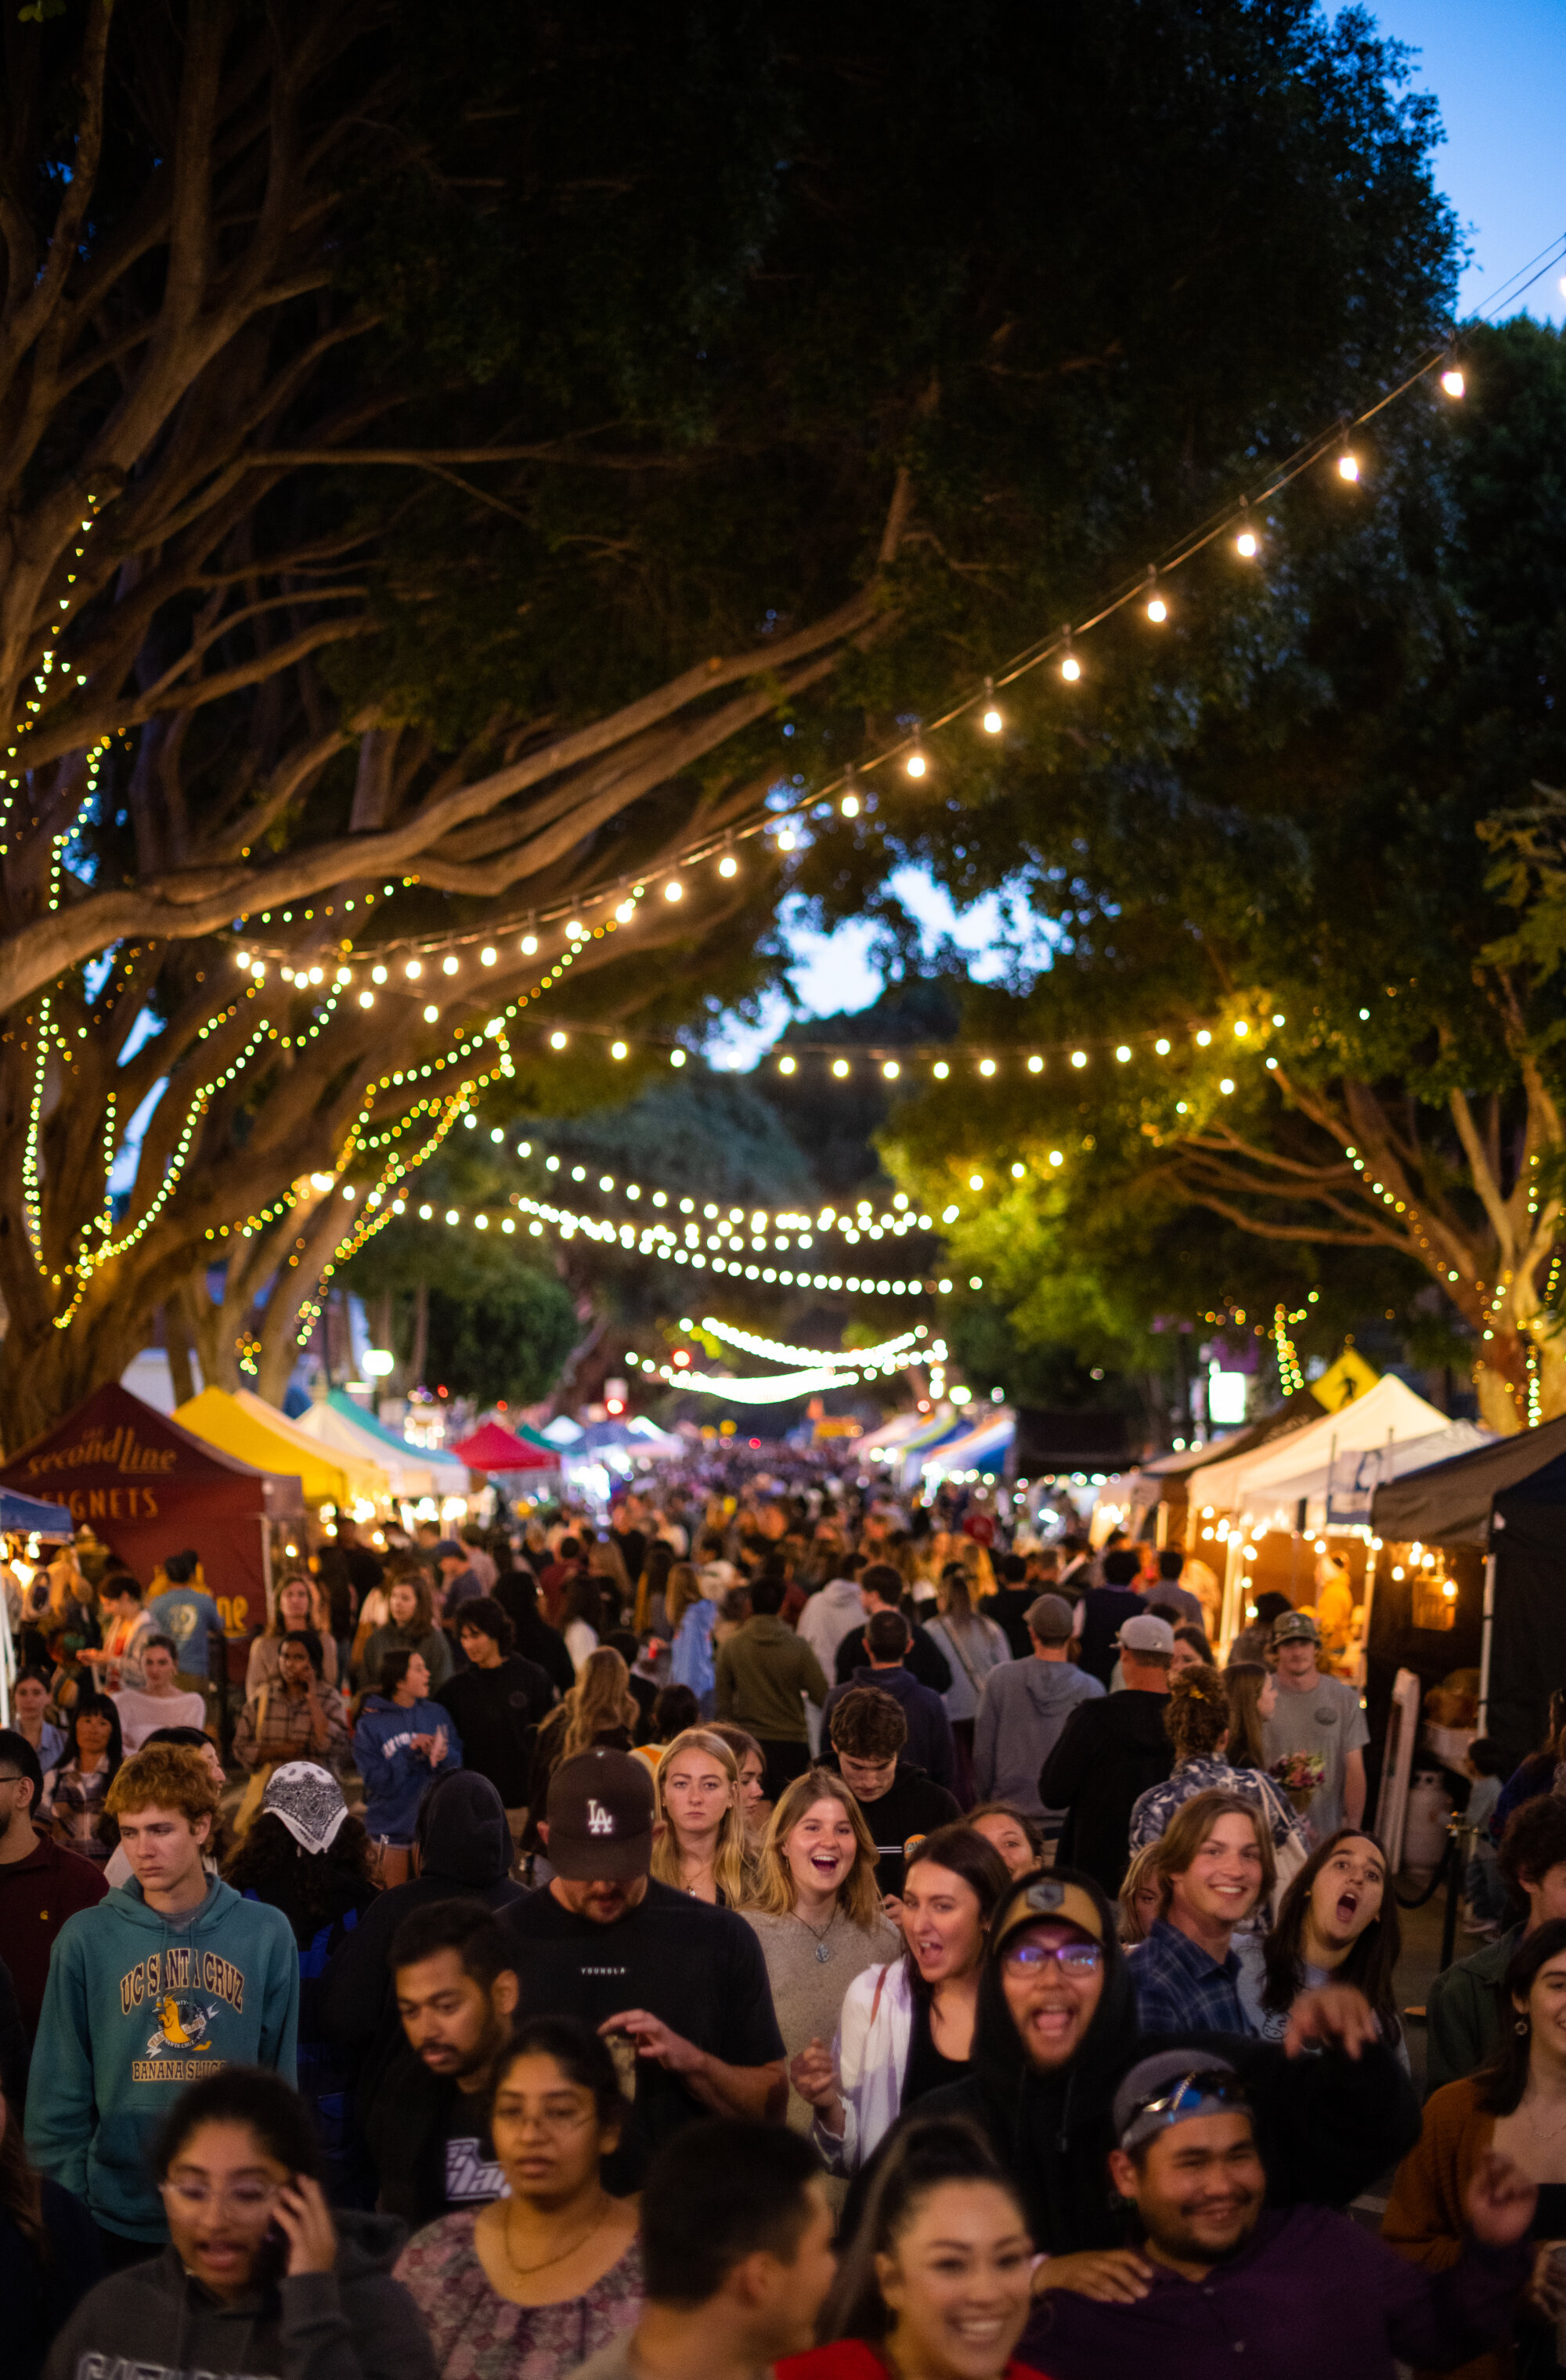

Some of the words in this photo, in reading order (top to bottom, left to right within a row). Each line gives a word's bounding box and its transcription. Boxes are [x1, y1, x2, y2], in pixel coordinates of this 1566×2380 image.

[587, 1799, 613, 1834] LA
[120, 1962, 145, 2015] UC
[203, 1951, 245, 2014] CRUZ
[132, 2061, 184, 2082] BANANA
